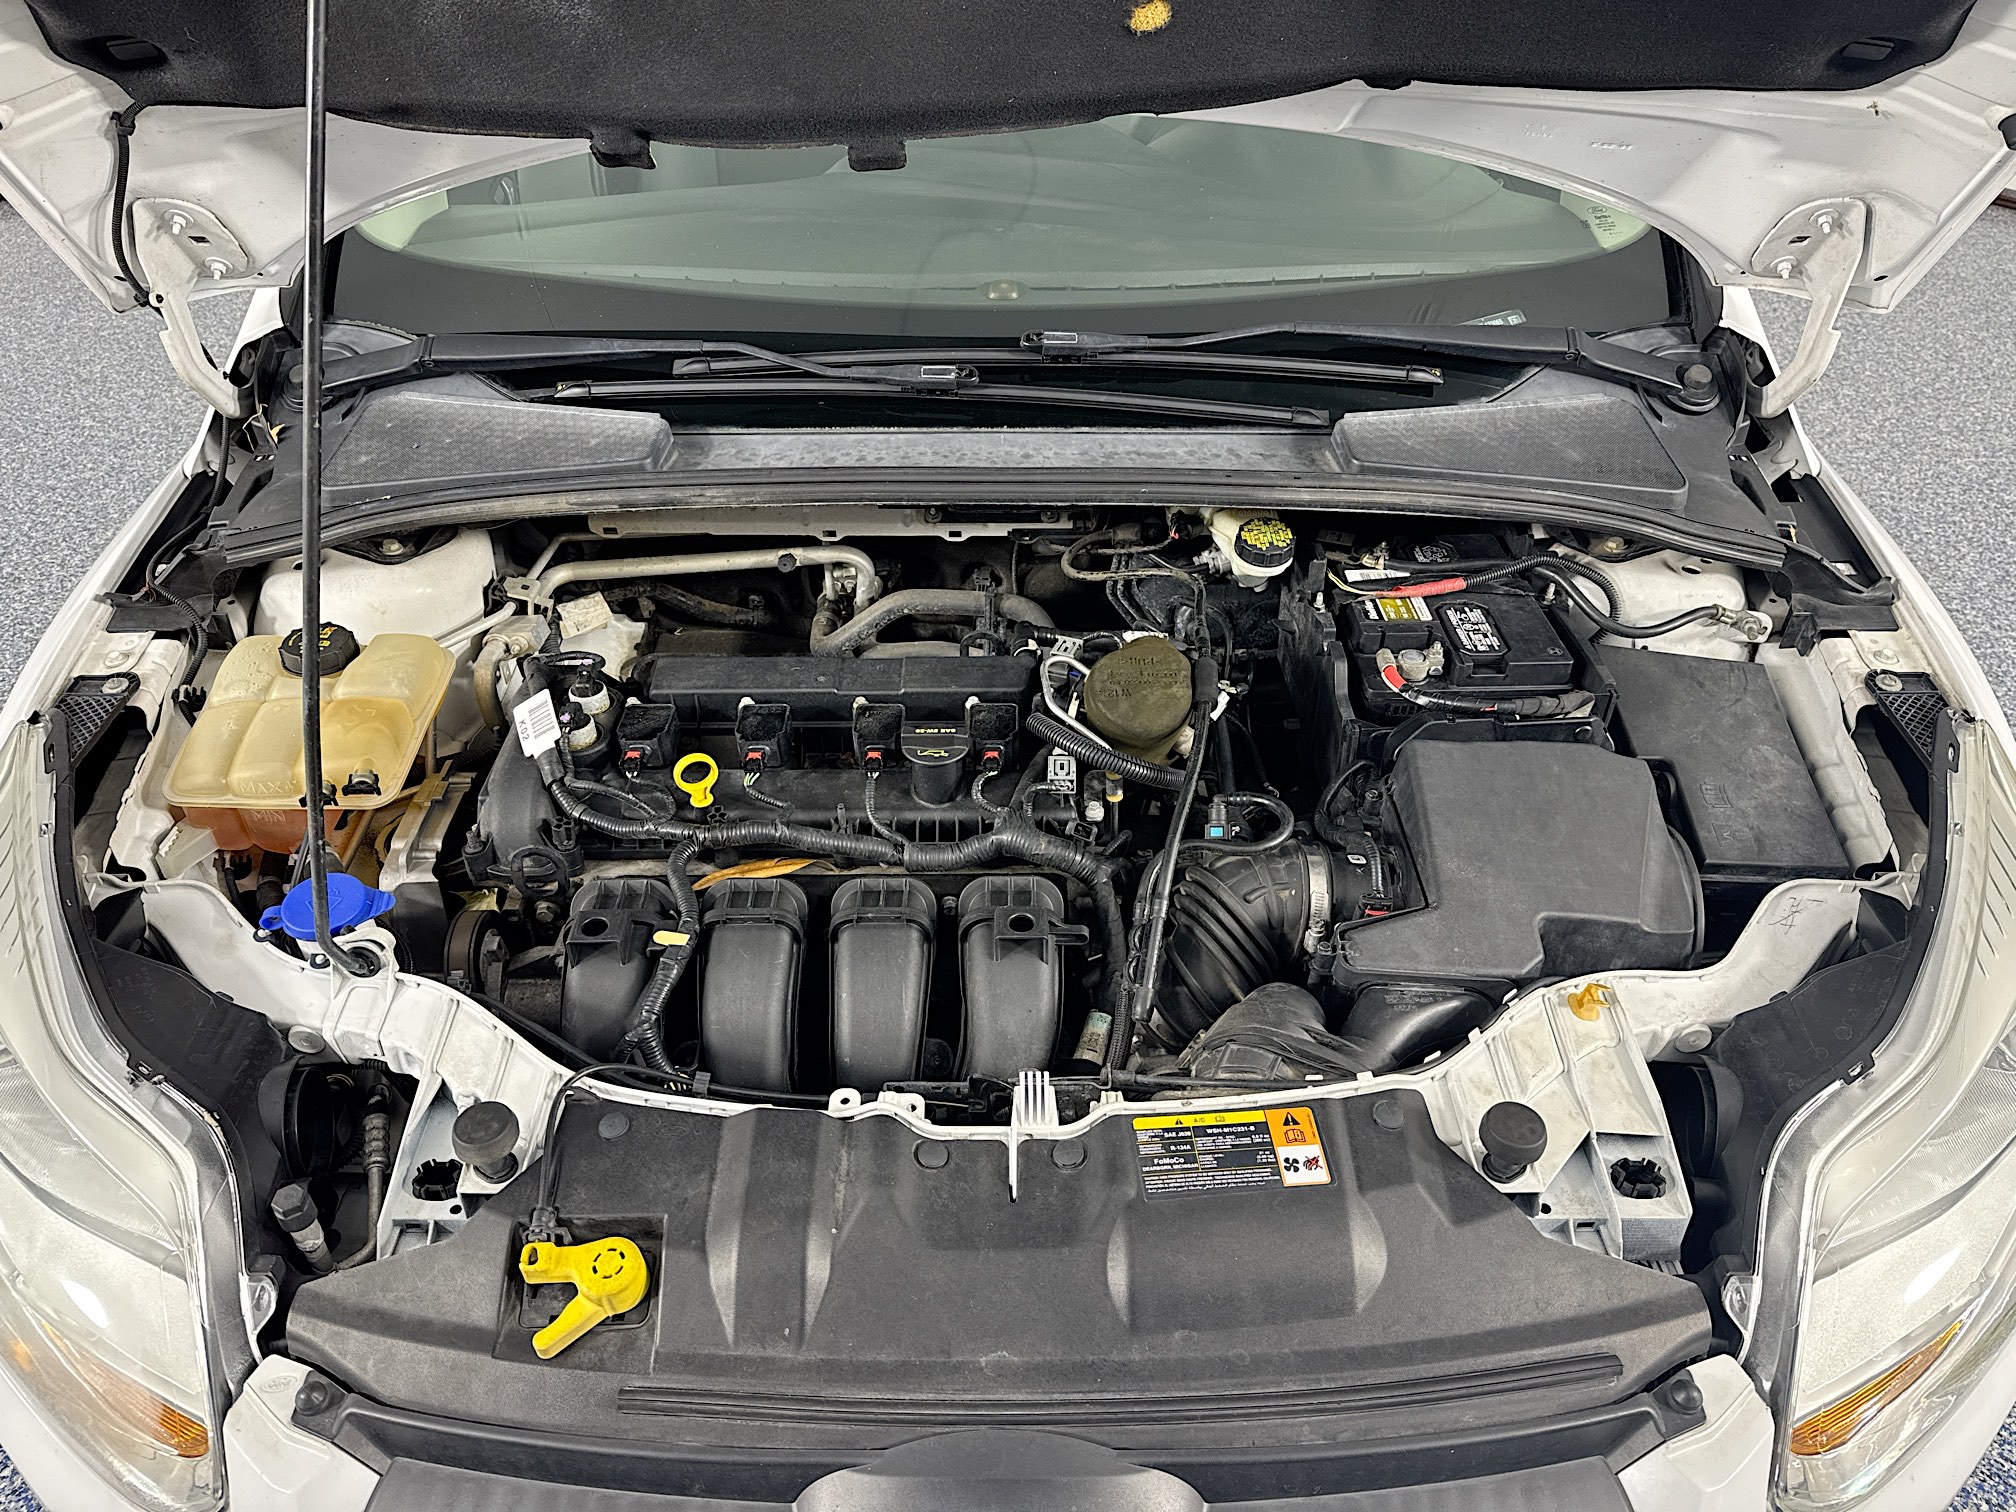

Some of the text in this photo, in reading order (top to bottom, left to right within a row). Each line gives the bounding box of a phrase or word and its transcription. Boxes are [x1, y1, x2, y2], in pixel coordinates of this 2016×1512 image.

[518, 719, 530, 742] K02
[240, 781, 283, 794] MAX
[250, 809, 286, 824] MIN
[1205, 1125, 1256, 1134] WSH-M1C231-B
[1153, 1157, 1185, 1165] FoMoCo
